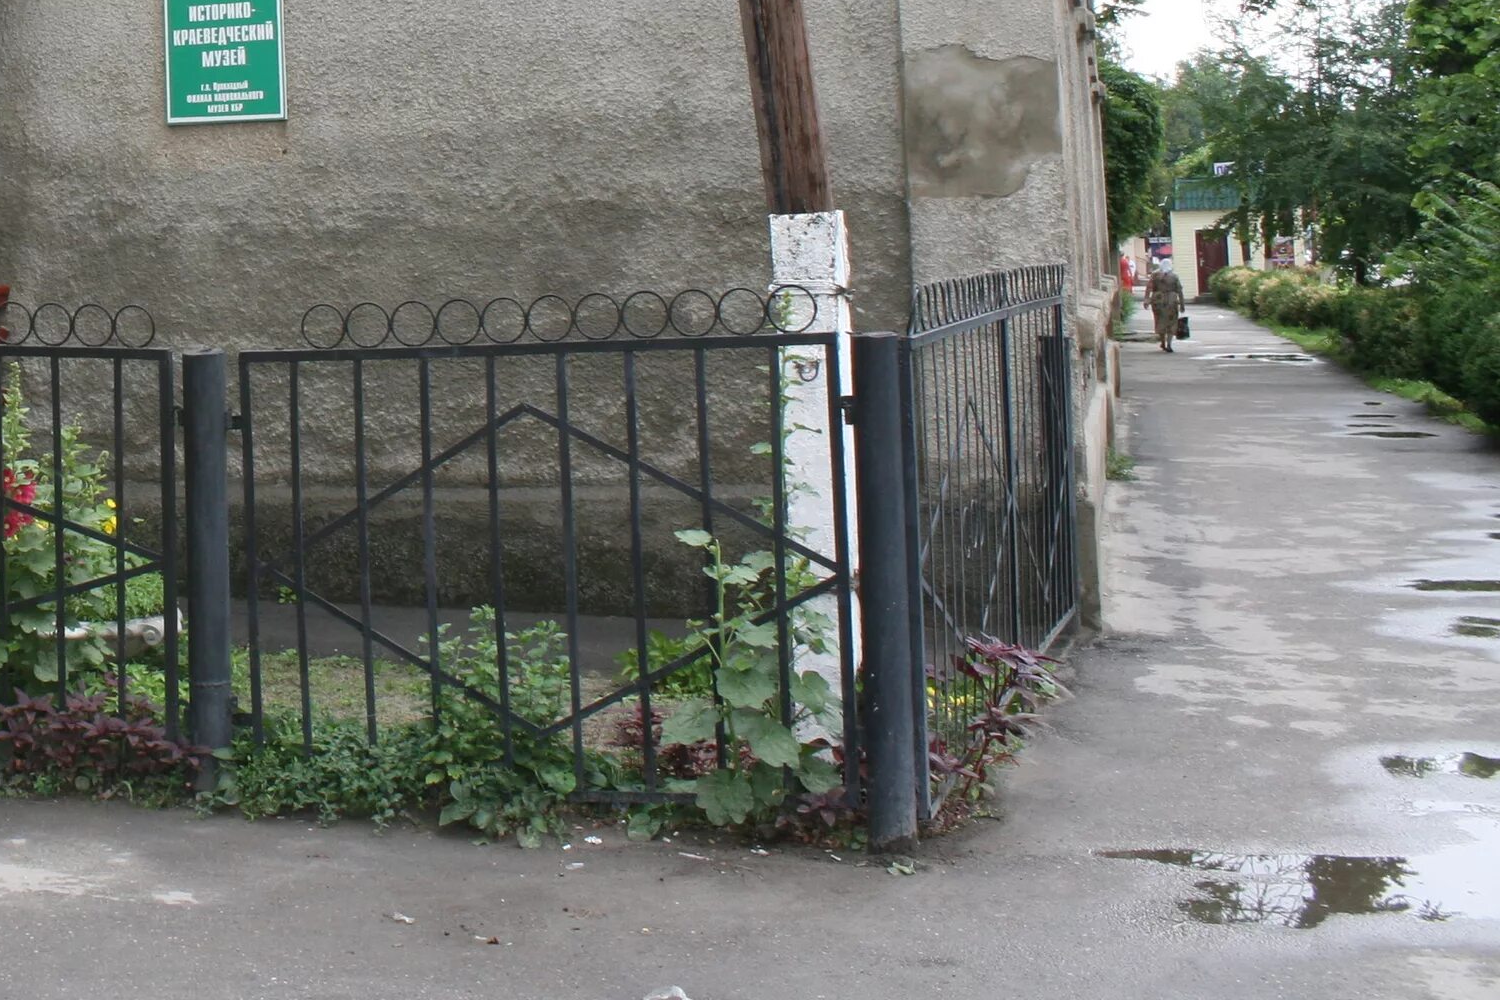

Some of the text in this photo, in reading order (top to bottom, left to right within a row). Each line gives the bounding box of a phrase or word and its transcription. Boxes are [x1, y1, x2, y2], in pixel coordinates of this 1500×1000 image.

[189, 2, 256, 22] ИСТОРИКО-
[173, 21, 273, 46] КРАЕВЕДЧЕСКИЙ
[202, 46, 246, 67] МУЗЕЙ
